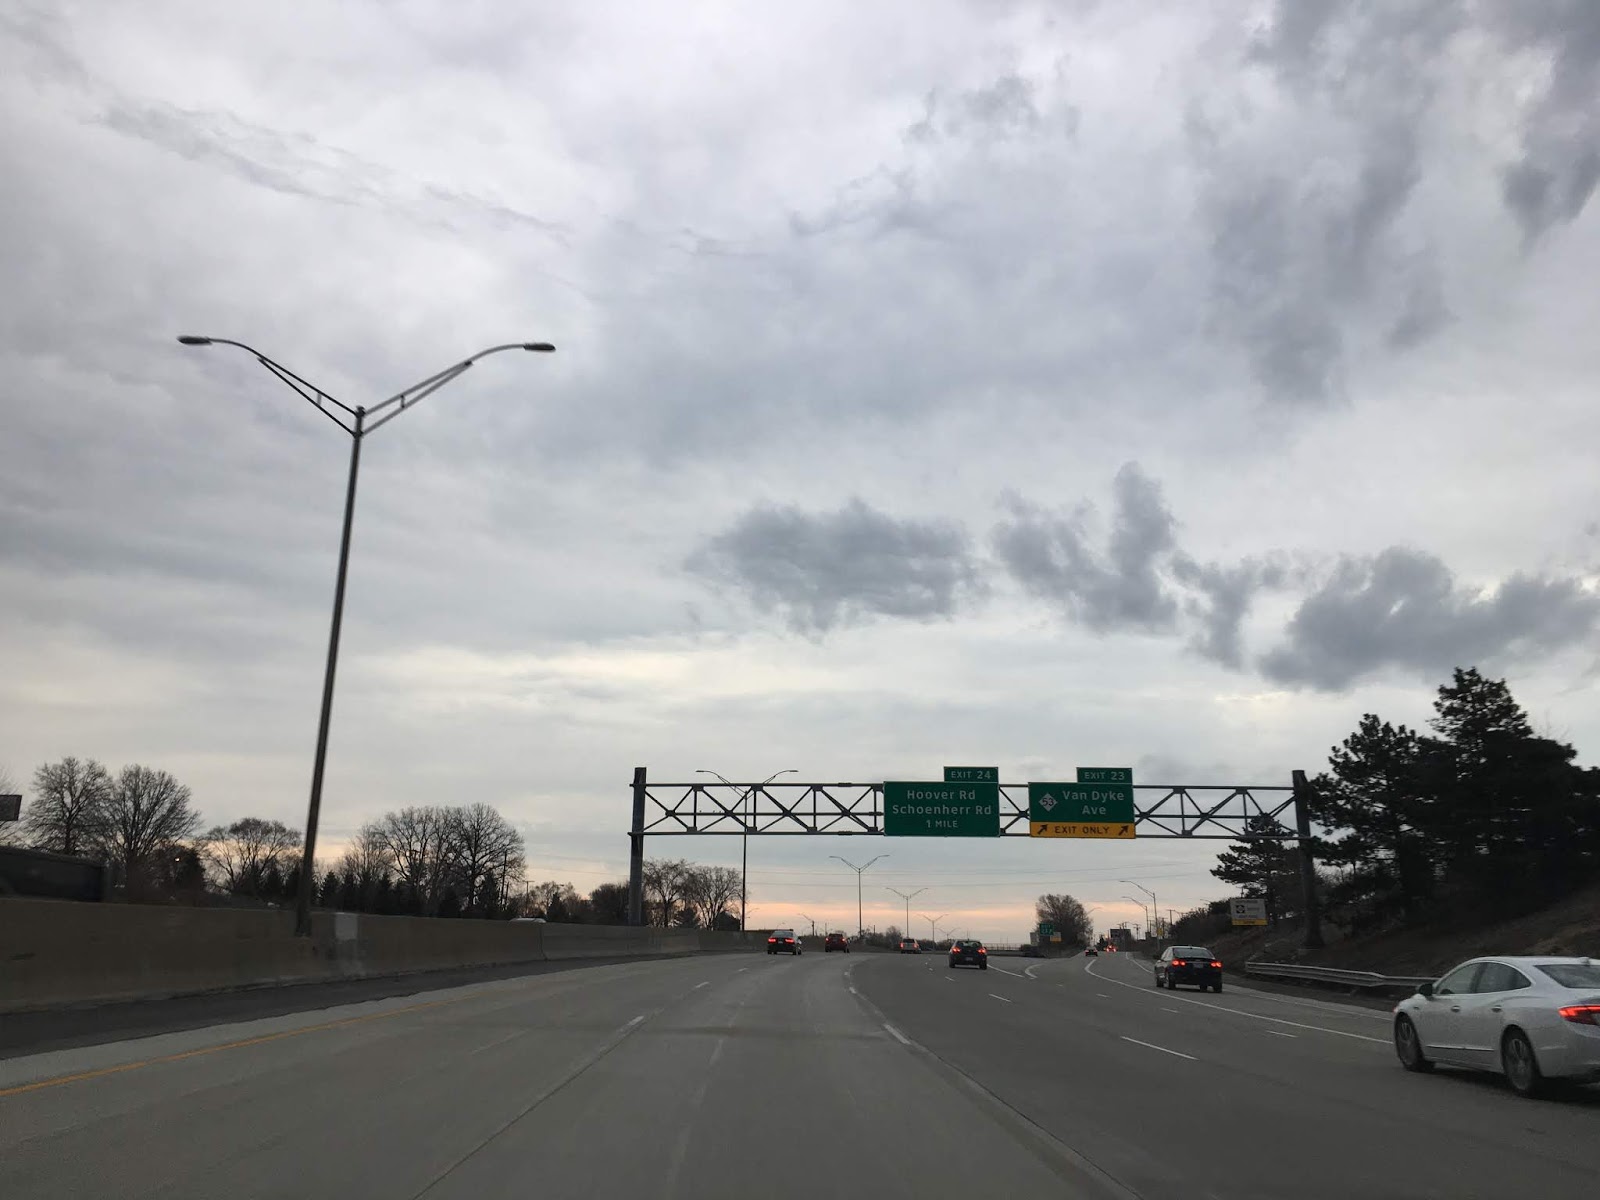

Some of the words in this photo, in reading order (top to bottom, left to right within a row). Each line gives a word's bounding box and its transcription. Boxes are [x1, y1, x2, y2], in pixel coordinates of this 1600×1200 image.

[976, 770, 992, 780] 24
[1110, 772, 1126, 780] 23
[907, 790, 954, 800] Hoover
[959, 790, 976, 800] Rd
[1062, 790, 1087, 800] Van
[1091, 790, 1125, 803] Dyke
[1042, 798, 1054, 806] 53
[892, 804, 972, 816] Schoenherr
[975, 804, 992, 816] Rd
[1082, 806, 1106, 815] Ave
[926, 820, 932, 828] 1
[935, 820, 958, 828] MILE
